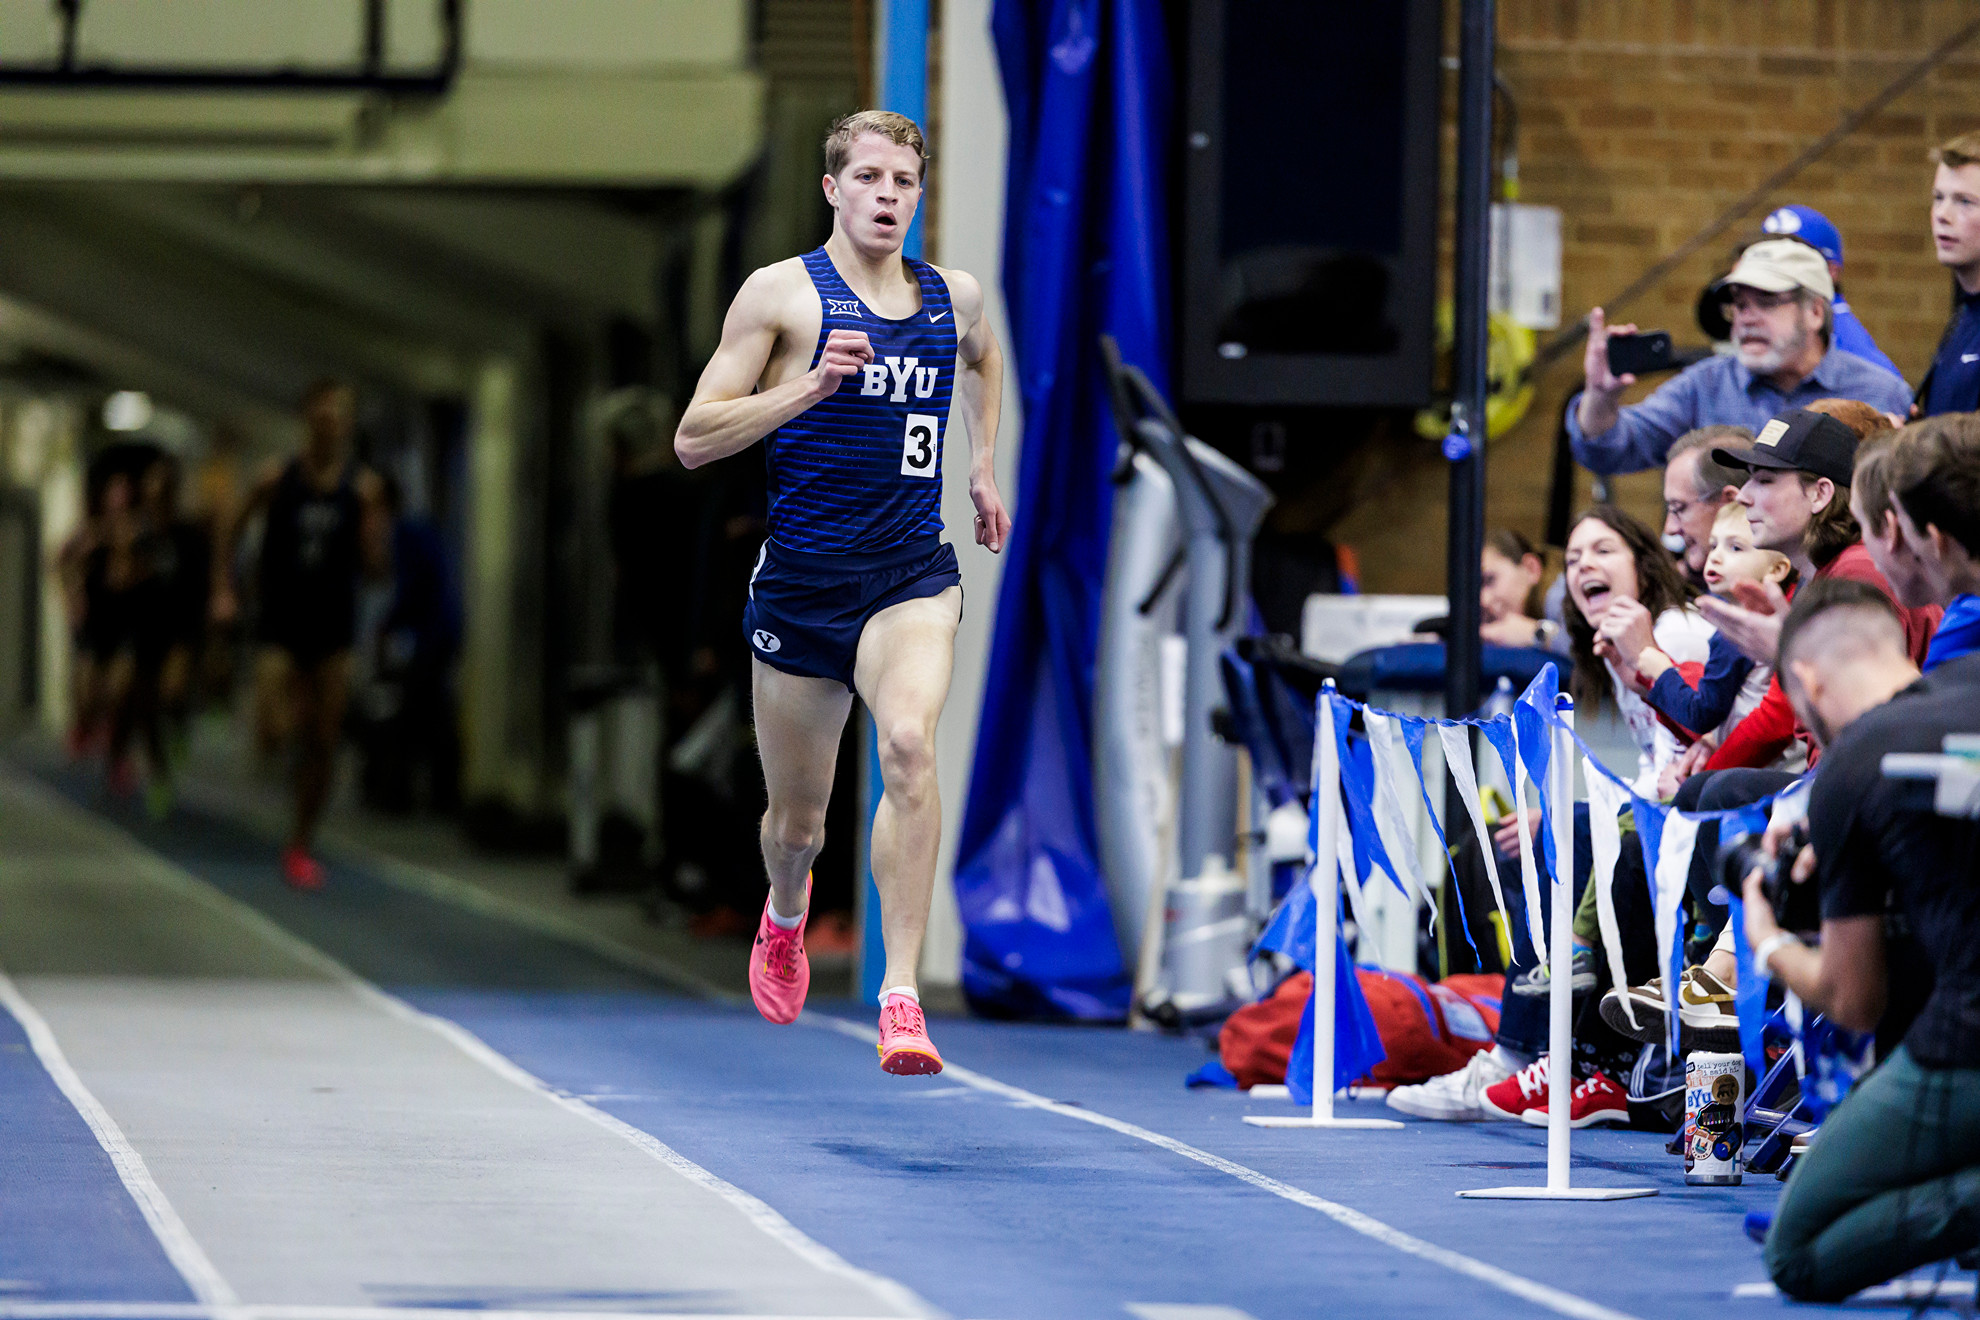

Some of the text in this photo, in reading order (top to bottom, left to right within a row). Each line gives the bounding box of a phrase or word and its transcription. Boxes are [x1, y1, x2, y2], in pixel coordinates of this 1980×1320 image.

[860, 356, 939, 403] BYU
[906, 425, 932, 470] 3
[756, 631, 775, 650] Y
[1697, 1062, 1711, 1070] tell
[1712, 1061, 1730, 1070] your
[1709, 1067, 1728, 1075] said
[1687, 1088, 1712, 1109] BYU
